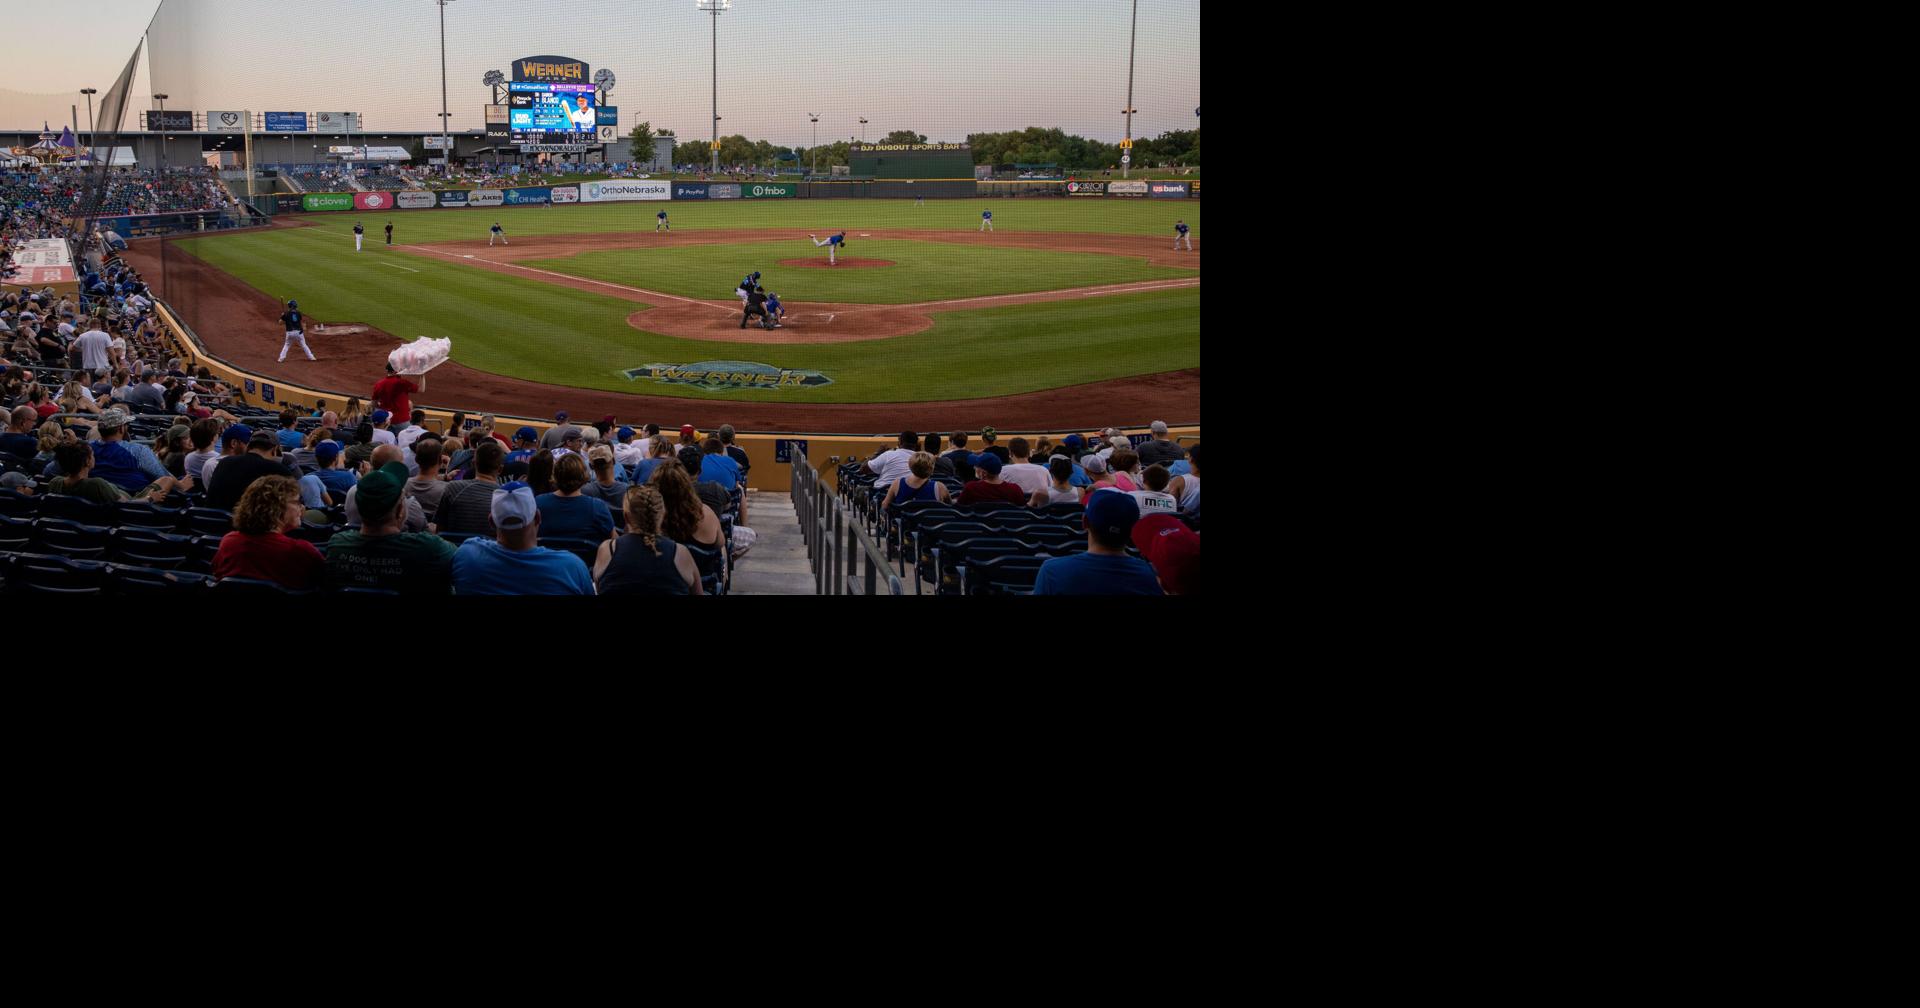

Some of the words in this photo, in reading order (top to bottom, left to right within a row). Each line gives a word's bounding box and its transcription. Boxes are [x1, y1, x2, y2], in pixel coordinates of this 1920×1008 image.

[521, 61, 582, 79] WERNER
[601, 186, 665, 195] OrthoNebraska
[765, 186, 786, 195] fnbo
[651, 366, 806, 386] WERNER
[348, 554, 368, 564] DOG
[370, 558, 401, 566] BEERS
[352, 565, 378, 574] ONLY
